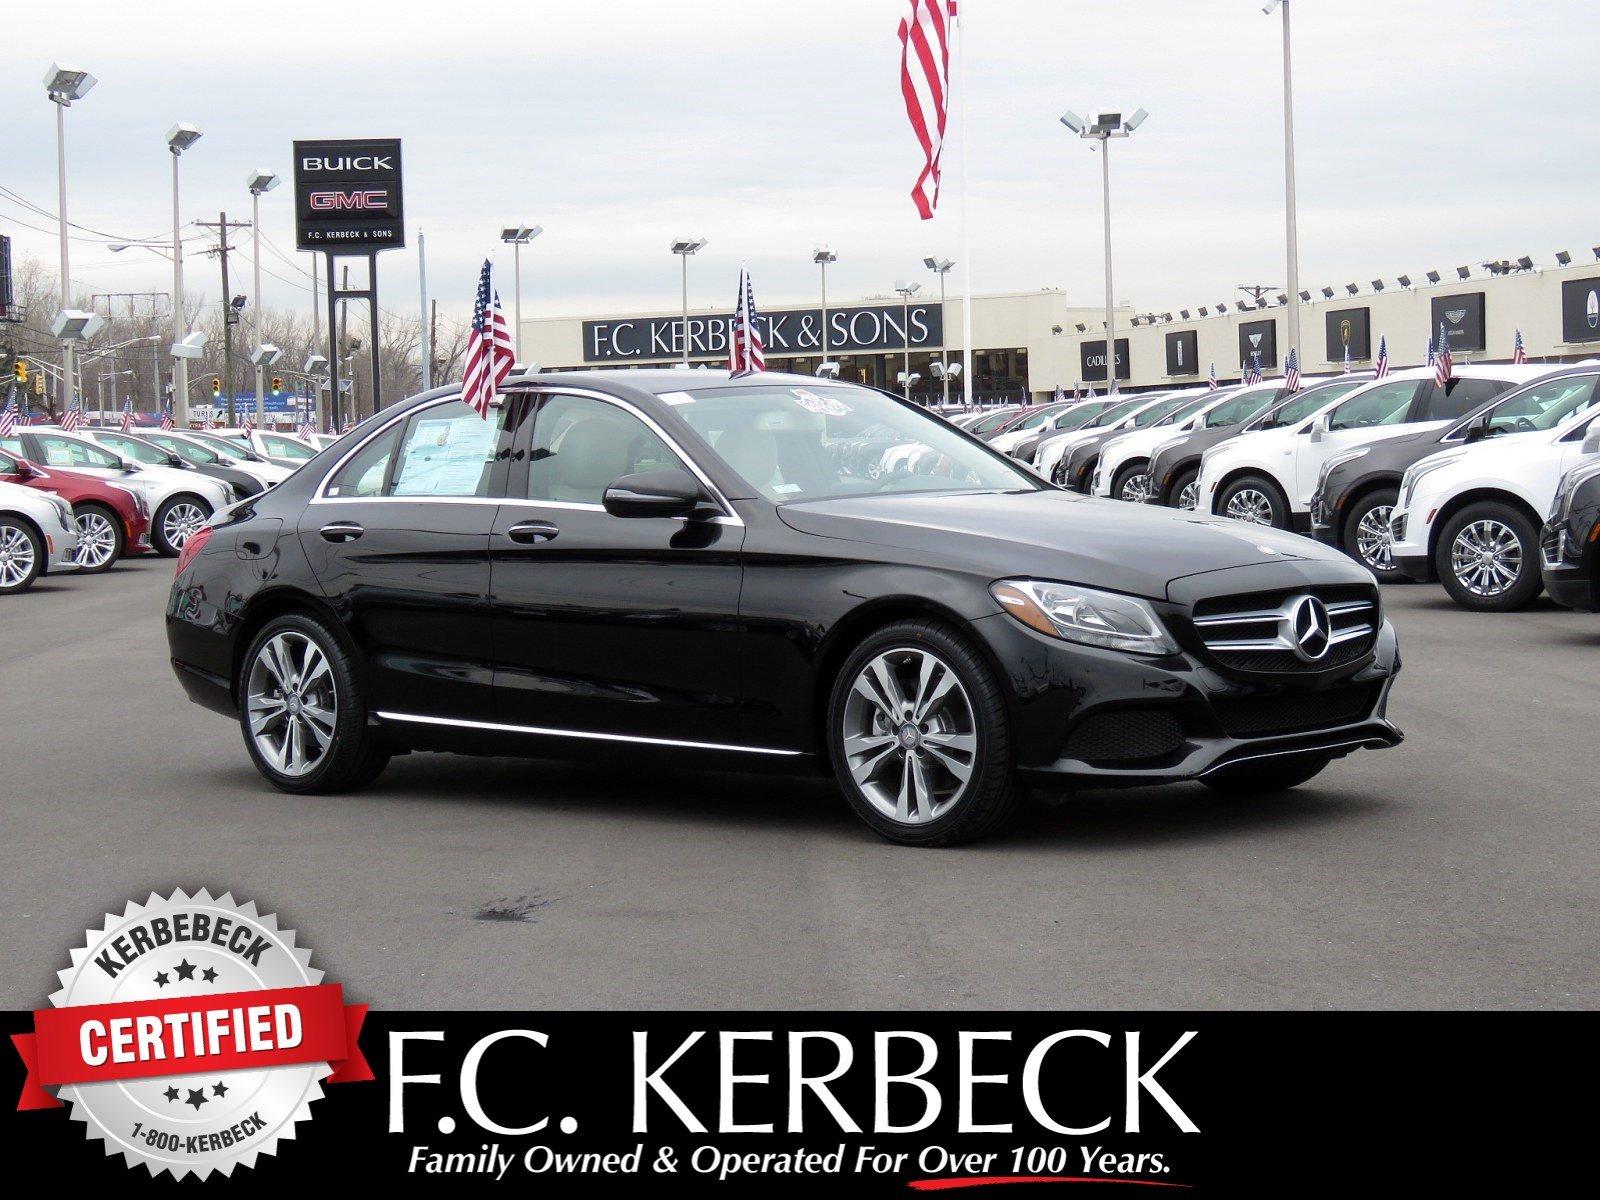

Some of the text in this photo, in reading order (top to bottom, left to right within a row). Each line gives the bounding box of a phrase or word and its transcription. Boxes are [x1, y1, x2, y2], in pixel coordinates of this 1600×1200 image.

[303, 157, 393, 170] BUICK
[310, 191, 388, 210] GMC
[308, 231, 322, 239] F.C.
[326, 230, 360, 239] KERBECK
[372, 230, 393, 238] SONS
[593, 308, 929, 356] F.C. KERBK & SONS
[1087, 353, 1121, 367] CADILLS
